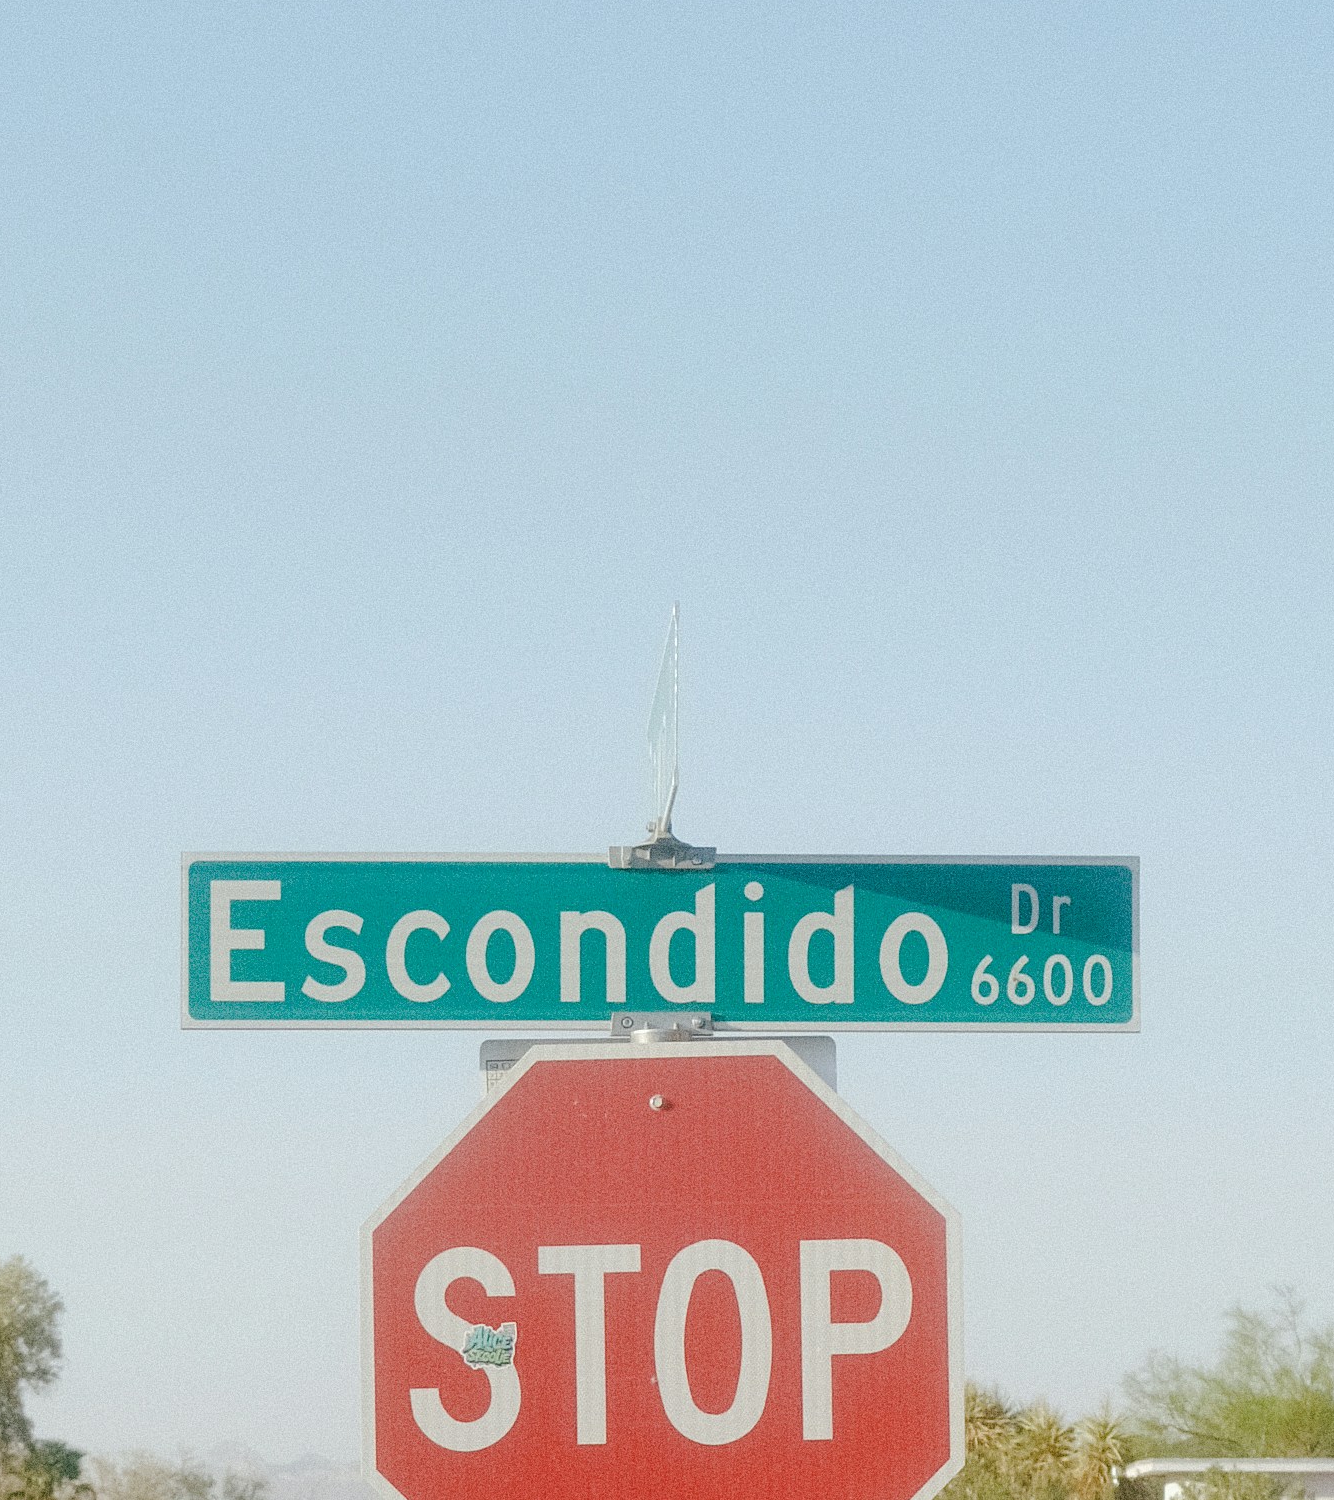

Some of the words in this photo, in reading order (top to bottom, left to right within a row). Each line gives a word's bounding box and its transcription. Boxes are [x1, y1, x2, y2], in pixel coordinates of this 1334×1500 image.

[210, 880, 948, 1005] Escondido
[1011, 883, 1072, 935] Dr
[971, 954, 1114, 1007] 6600
[409, 1237, 914, 1453] STOP
